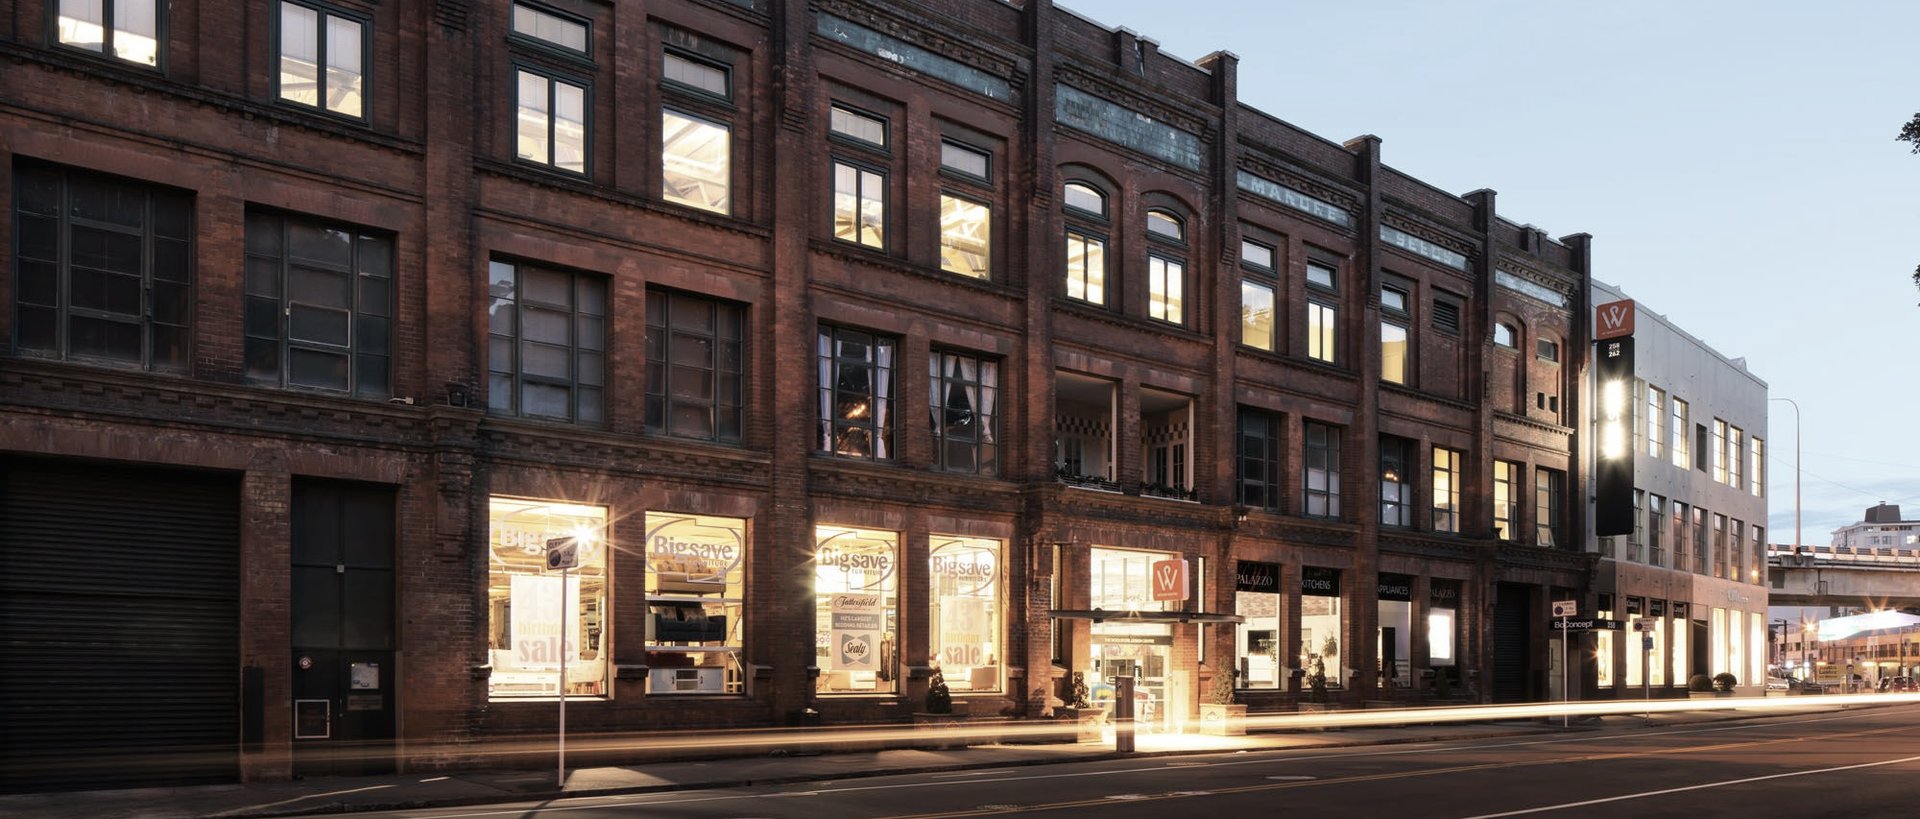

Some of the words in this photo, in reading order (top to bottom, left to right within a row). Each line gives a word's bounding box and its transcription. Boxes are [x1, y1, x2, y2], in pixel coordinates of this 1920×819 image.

[1236, 573, 1273, 587] PALAZZO
[1554, 620, 1593, 629] BoConcept
[845, 641, 867, 657] Sealy
[945, 643, 981, 665] sale
